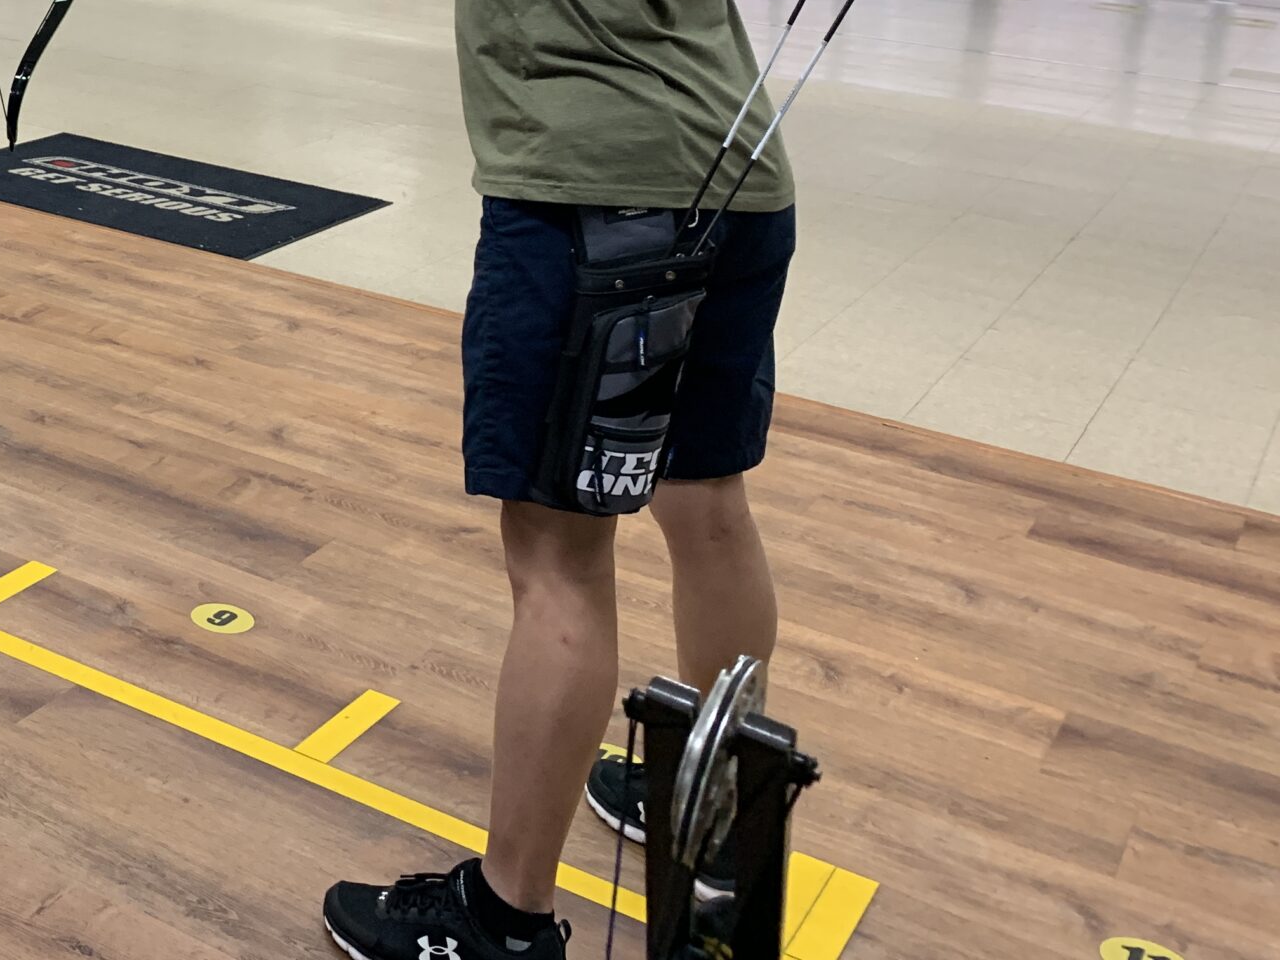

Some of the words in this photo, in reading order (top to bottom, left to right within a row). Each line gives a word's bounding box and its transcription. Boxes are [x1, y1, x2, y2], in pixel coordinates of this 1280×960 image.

[8, 167, 88, 185] GET
[75, 183, 245, 223] SERIOUS
[206, 609, 238, 627] 9
